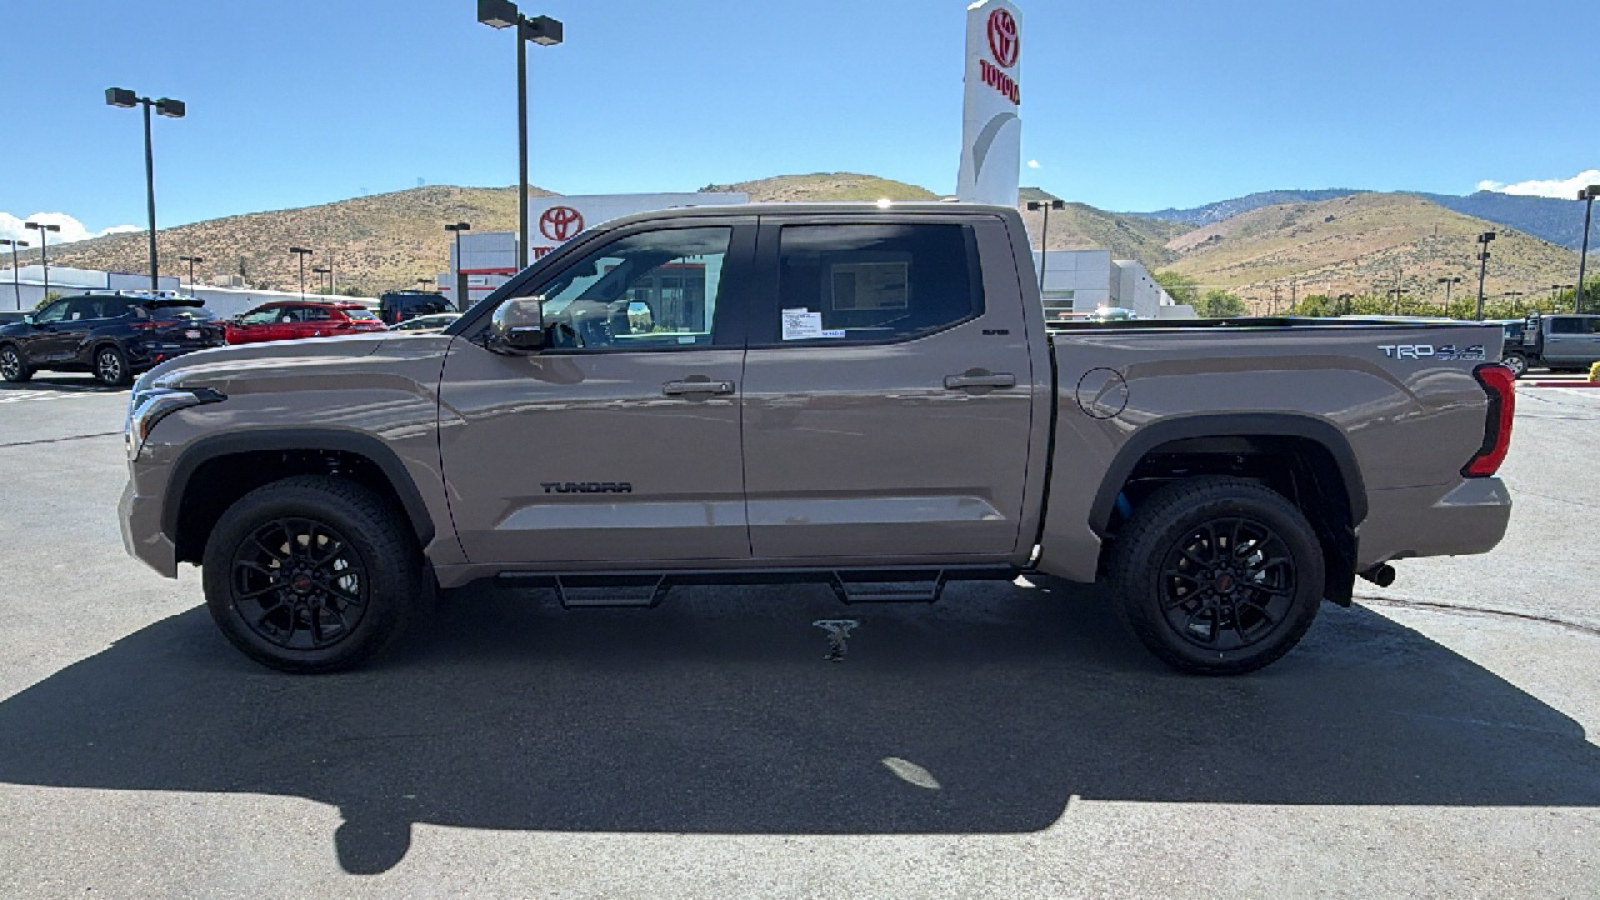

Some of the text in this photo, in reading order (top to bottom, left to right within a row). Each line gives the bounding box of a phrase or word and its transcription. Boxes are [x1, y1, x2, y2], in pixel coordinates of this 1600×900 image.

[979, 59, 1021, 106] TOYOTA
[1377, 344, 1435, 360] TRD
[540, 482, 632, 493] TUNDRA
